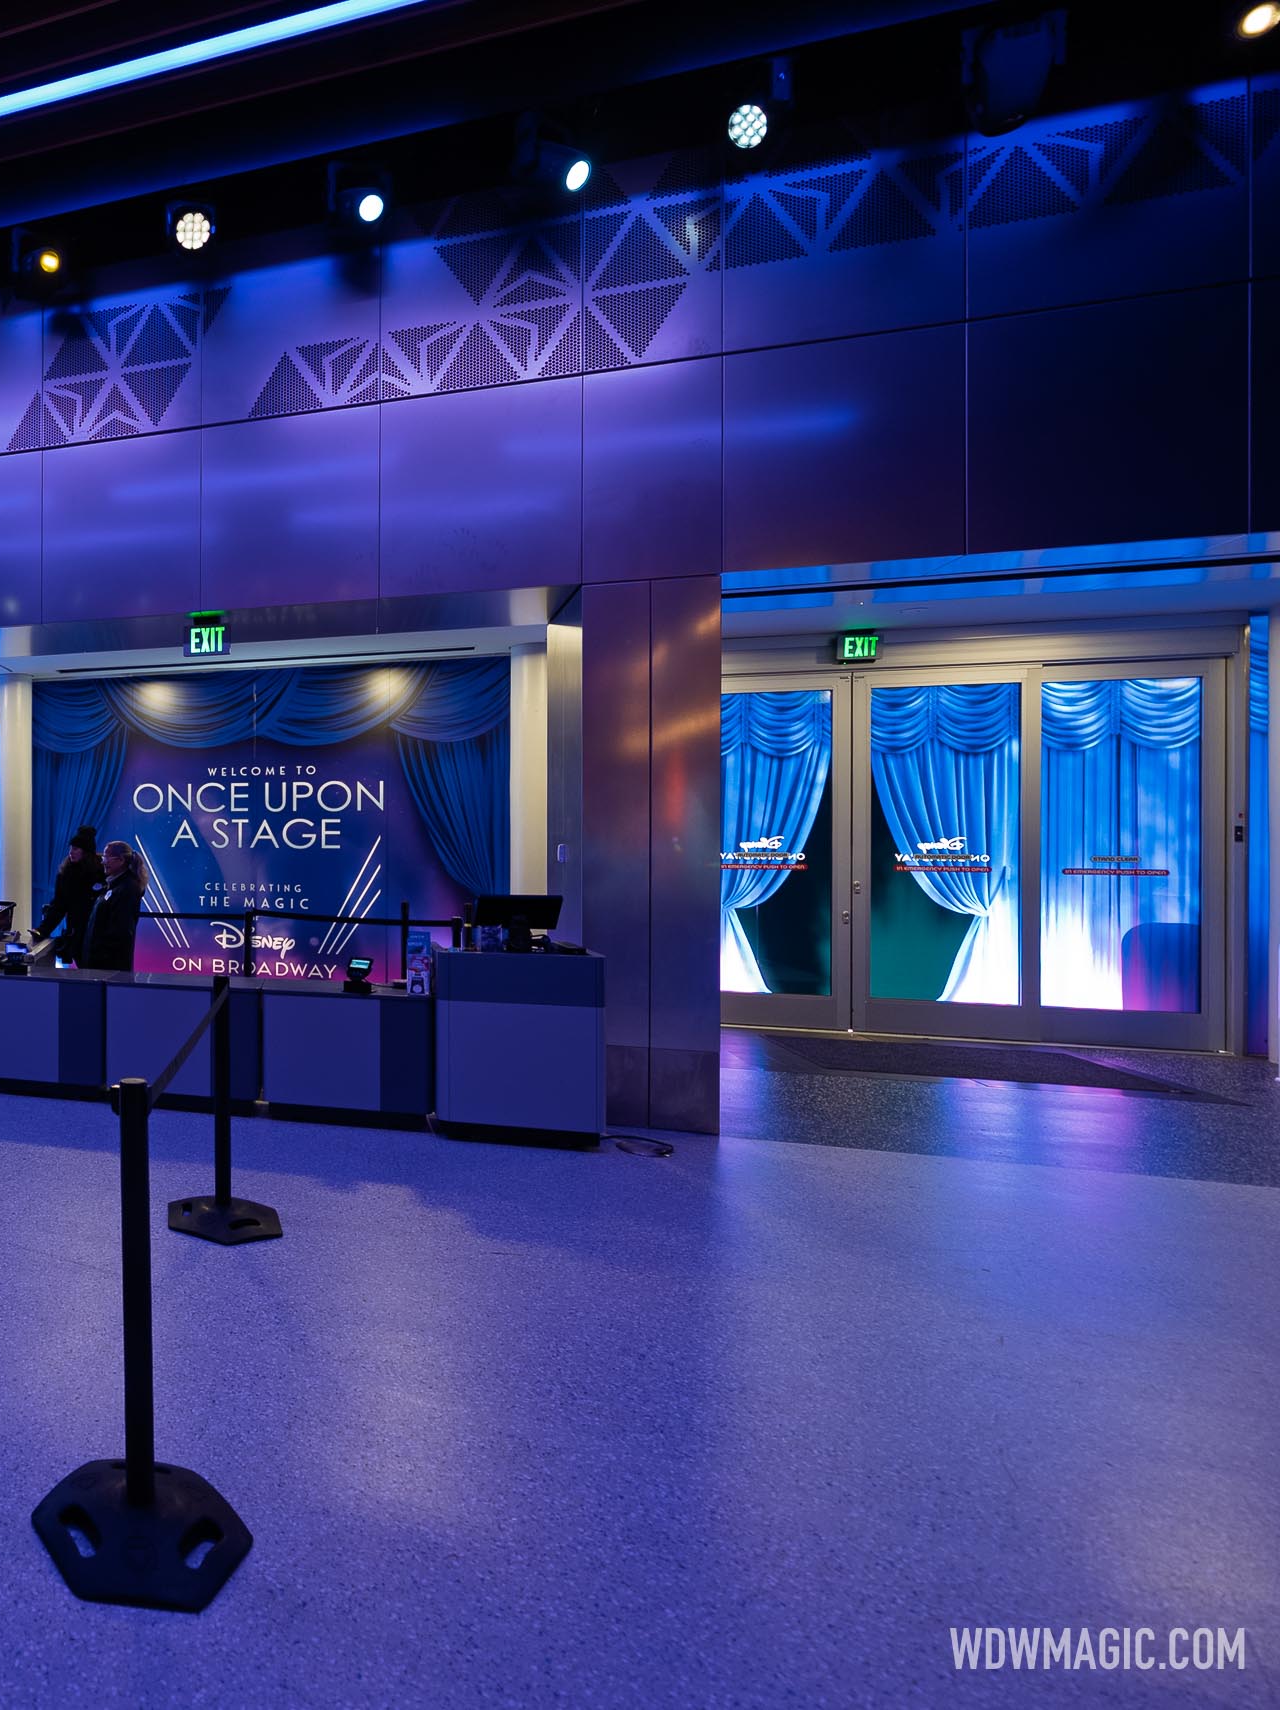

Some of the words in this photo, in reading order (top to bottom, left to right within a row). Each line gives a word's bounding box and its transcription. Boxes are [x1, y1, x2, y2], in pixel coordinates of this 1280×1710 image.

[190, 627, 225, 654] EXIT
[844, 636, 879, 658] EXIT
[207, 766, 286, 777] WELCOME
[296, 765, 317, 776] TO
[132, 781, 249, 813] ONCE
[264, 780, 385, 812] UPON
[170, 819, 199, 848] A
[211, 818, 341, 849] STAGE
[204, 882, 302, 893] CELEBRATING
[199, 895, 231, 908] THE
[244, 897, 310, 910] MAGIC
[172, 957, 202, 972] ON
